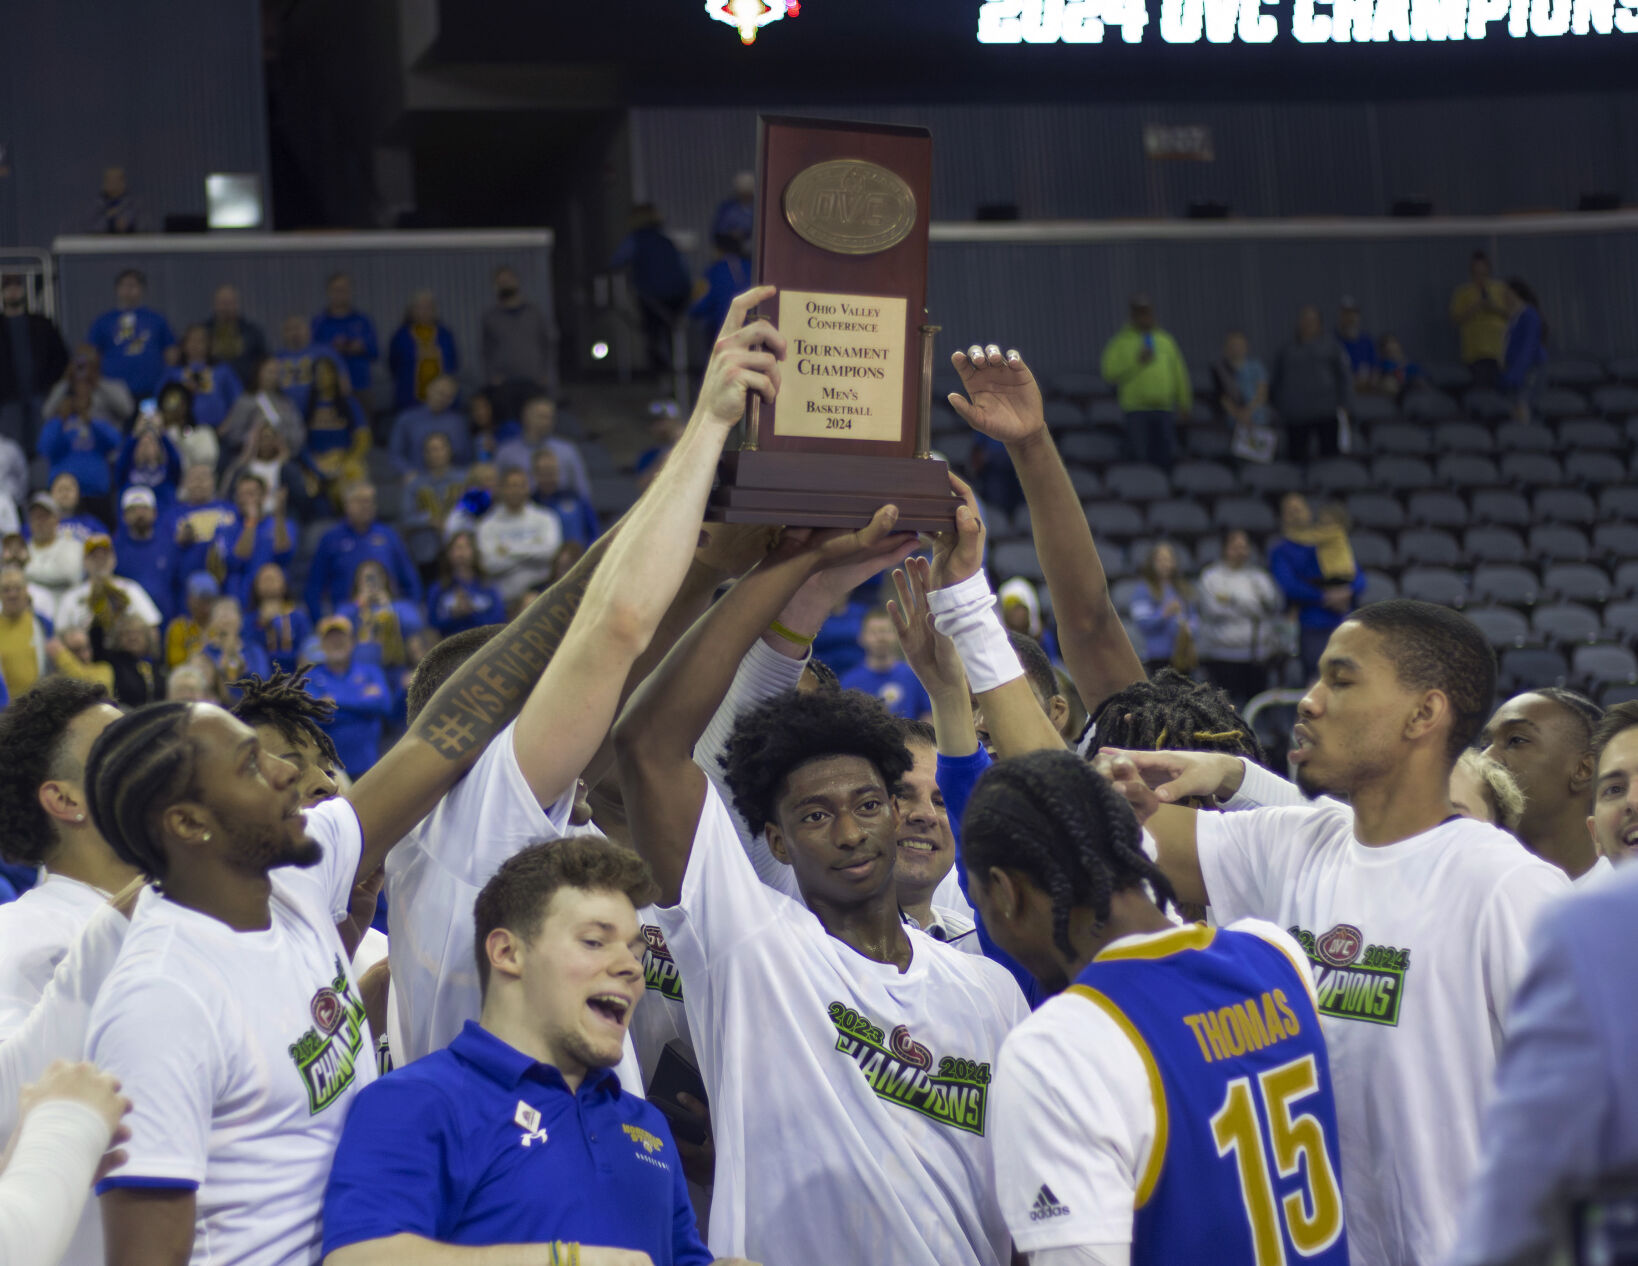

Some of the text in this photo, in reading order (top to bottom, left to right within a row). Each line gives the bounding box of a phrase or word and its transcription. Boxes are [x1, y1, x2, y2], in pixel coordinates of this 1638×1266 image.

[977, 0, 1149, 43] 2024
[1160, 0, 1279, 43] OVC
[826, 418, 852, 430] 2024
[828, 1001, 885, 1045] 2023
[1183, 988, 1300, 1063] THOMAS
[938, 1056, 991, 1084] 2024
[1209, 1053, 1344, 1266] 15
